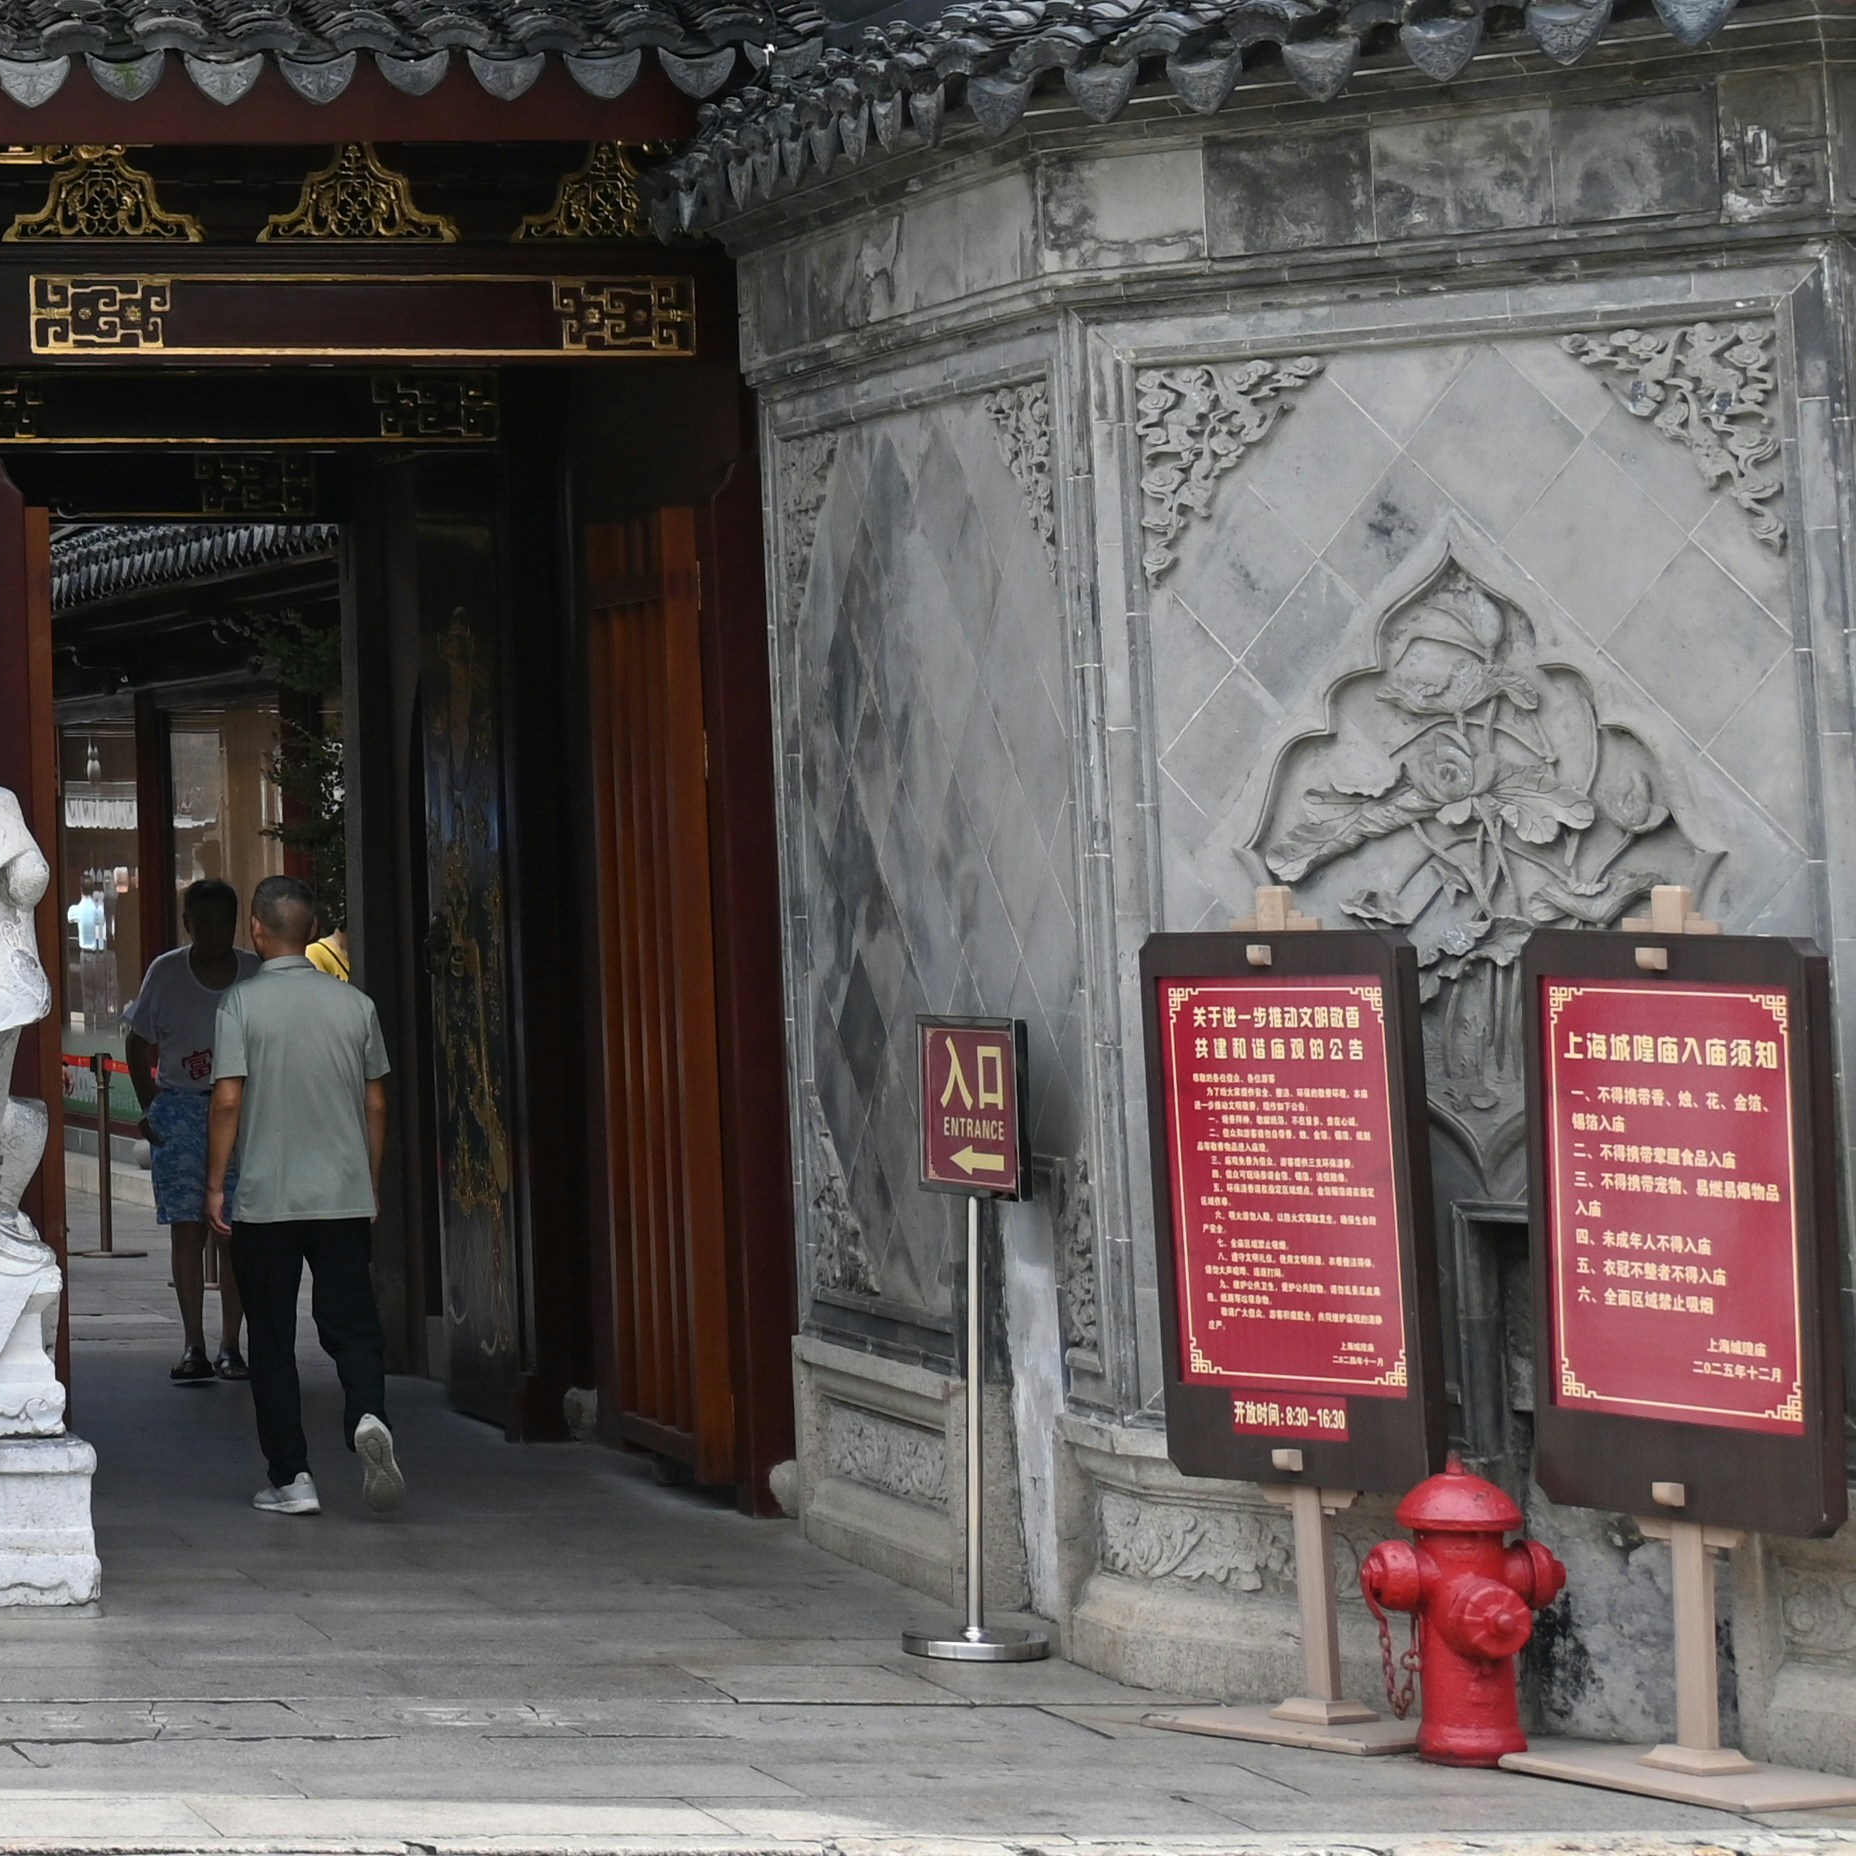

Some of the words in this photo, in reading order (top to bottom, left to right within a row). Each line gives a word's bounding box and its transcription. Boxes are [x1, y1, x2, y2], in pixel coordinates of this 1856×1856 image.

[1192, 1006, 1361, 1029] 关于进一步推动文明敬香
[1194, 1037, 1365, 1061] 共建和谐庙观的公告
[1563, 1031, 1779, 1070] 上海城隍庙入庙须知
[939, 1035, 1004, 1111] 入口
[943, 1116, 1005, 1141] ENTRANCE
[1571, 1112, 1626, 1133] 锡箔入庙
[1573, 1170, 1780, 1202] 三、不得携带宠物、易燃易爆物品
[1574, 1199, 1602, 1218] 入庙
[1575, 1228, 1712, 1256] 四、未成年人不得入庙
[1576, 1256, 1727, 1287] 五、衣冠不整者不得入庙
[1706, 1337, 1767, 1358] 上海城隍庙
